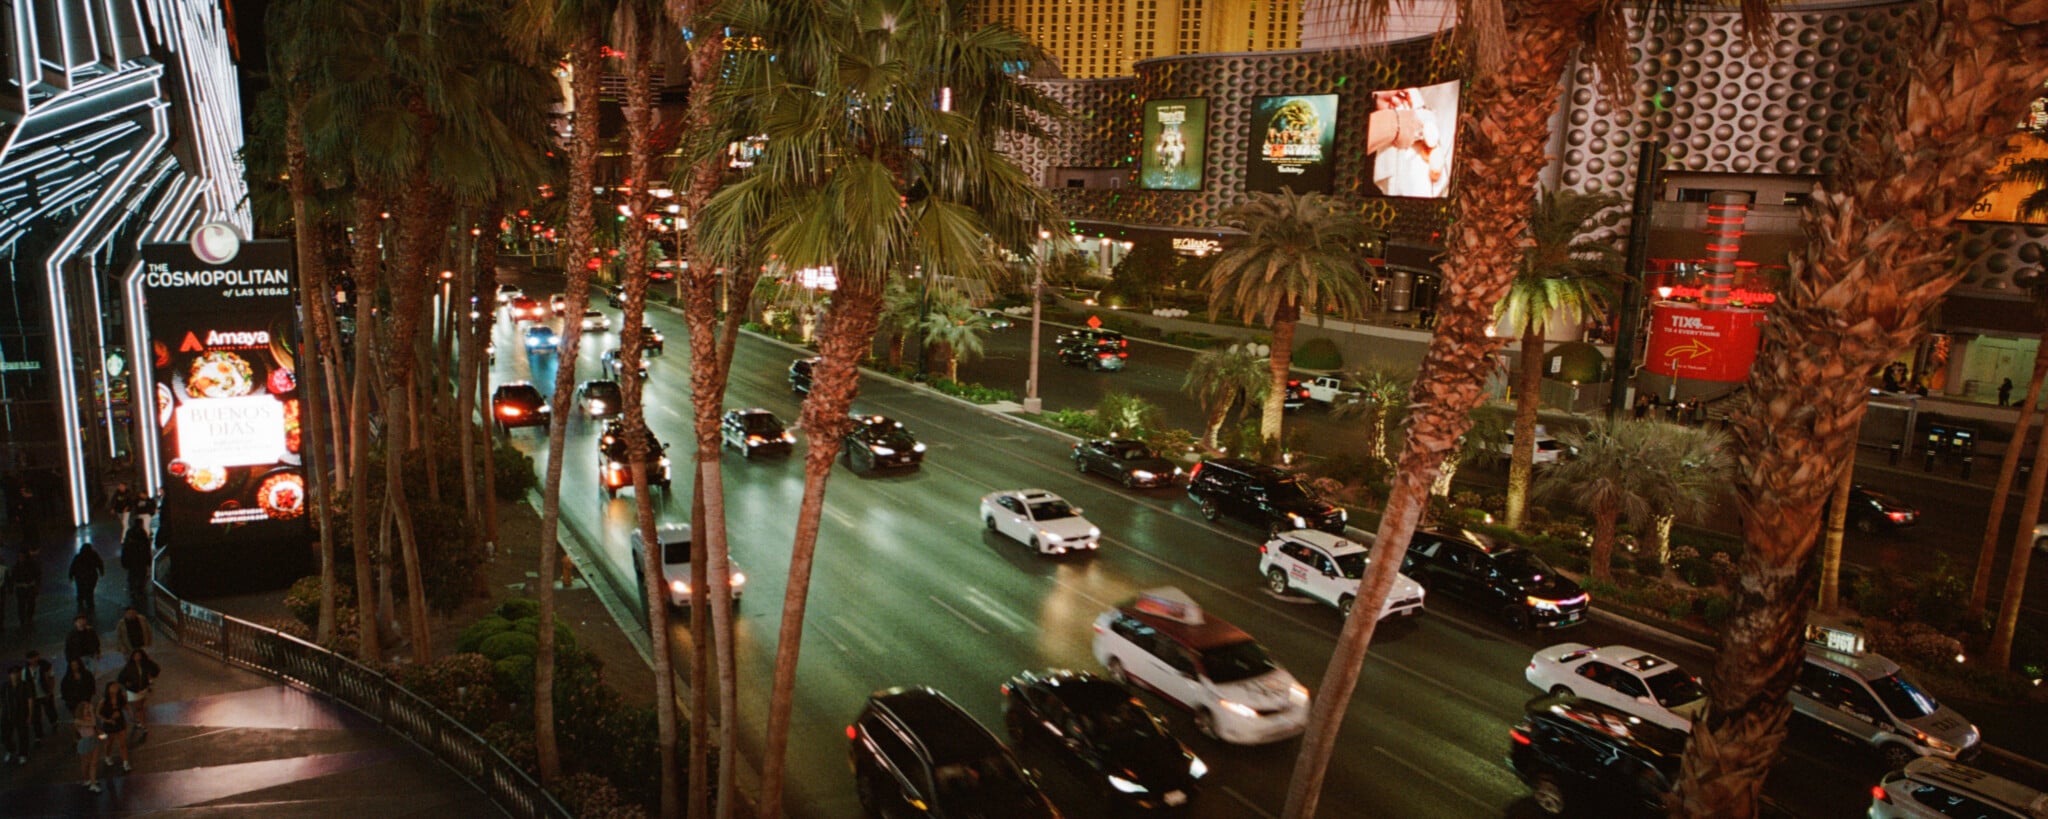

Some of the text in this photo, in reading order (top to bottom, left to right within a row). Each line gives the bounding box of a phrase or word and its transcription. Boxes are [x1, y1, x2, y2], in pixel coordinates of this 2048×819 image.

[148, 263, 169, 273] THE
[147, 269, 288, 288] COSMOPOLITAN
[222, 287, 289, 298] of LAS VEGAS
[206, 330, 270, 346] Amaya
[1679, 328, 1720, 337] EVERYTHING
[190, 406, 271, 422] BUENOS
